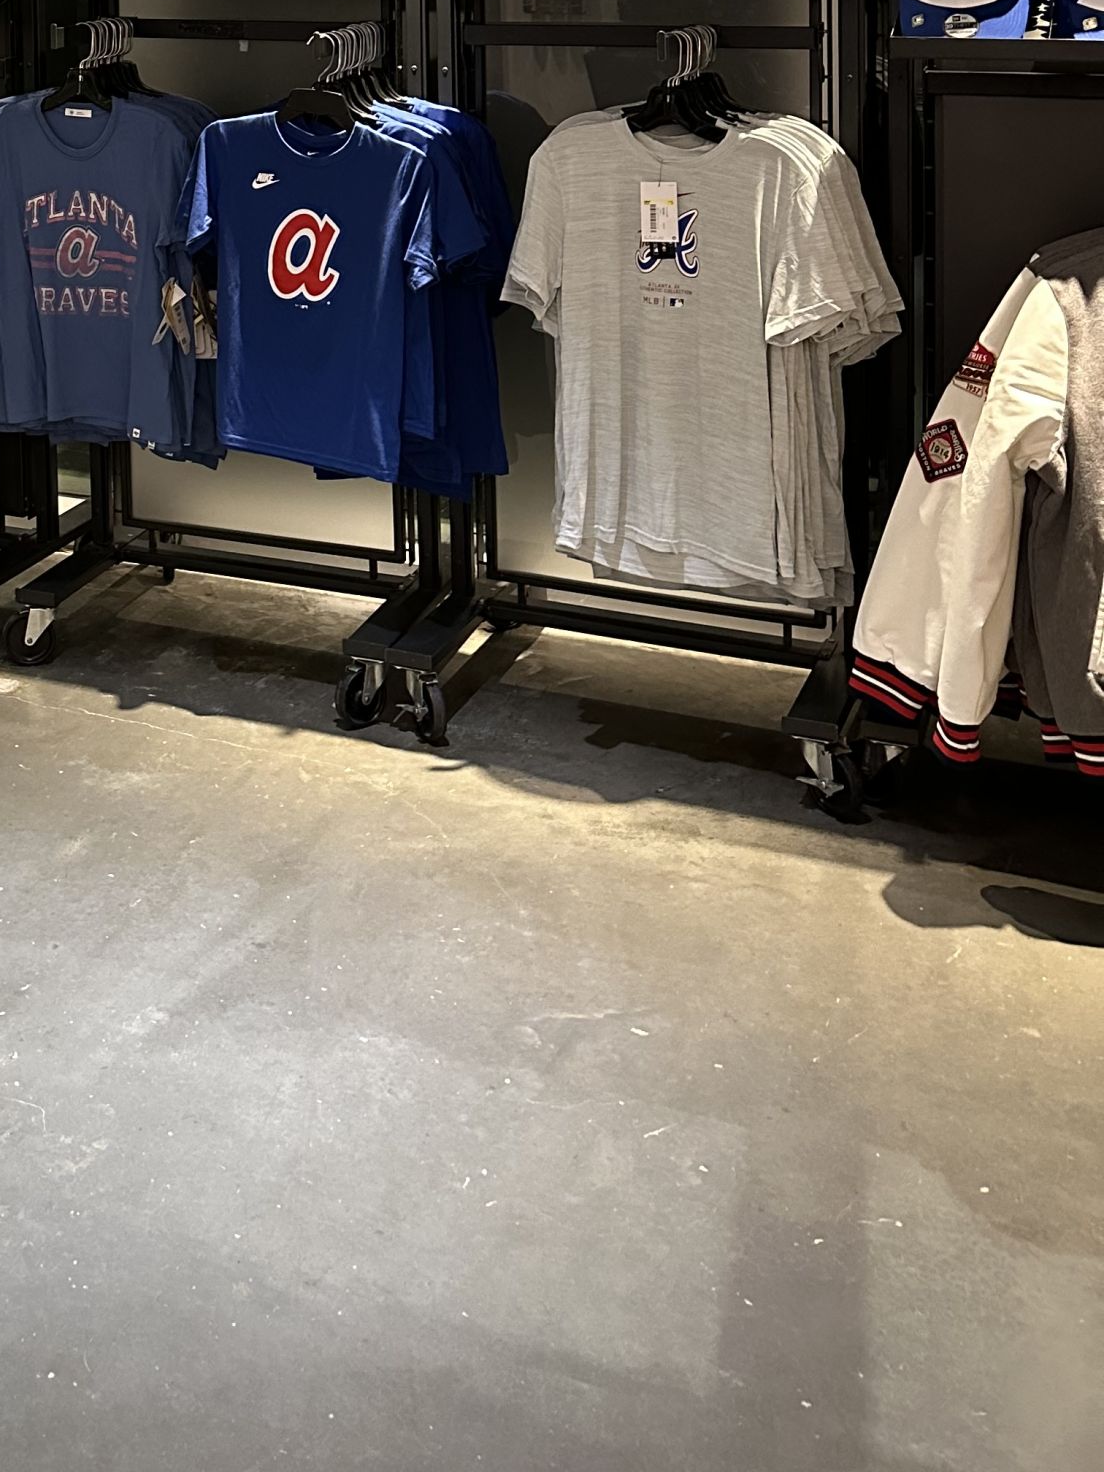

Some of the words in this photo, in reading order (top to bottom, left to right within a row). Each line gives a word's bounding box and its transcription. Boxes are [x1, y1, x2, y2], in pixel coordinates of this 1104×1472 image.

[266, 208, 341, 302] a
[34, 287, 131, 318] RAVES
[966, 382, 982, 395] 1957
[930, 441, 950, 460] 1914
[934, 463, 962, 476] BRAVES
